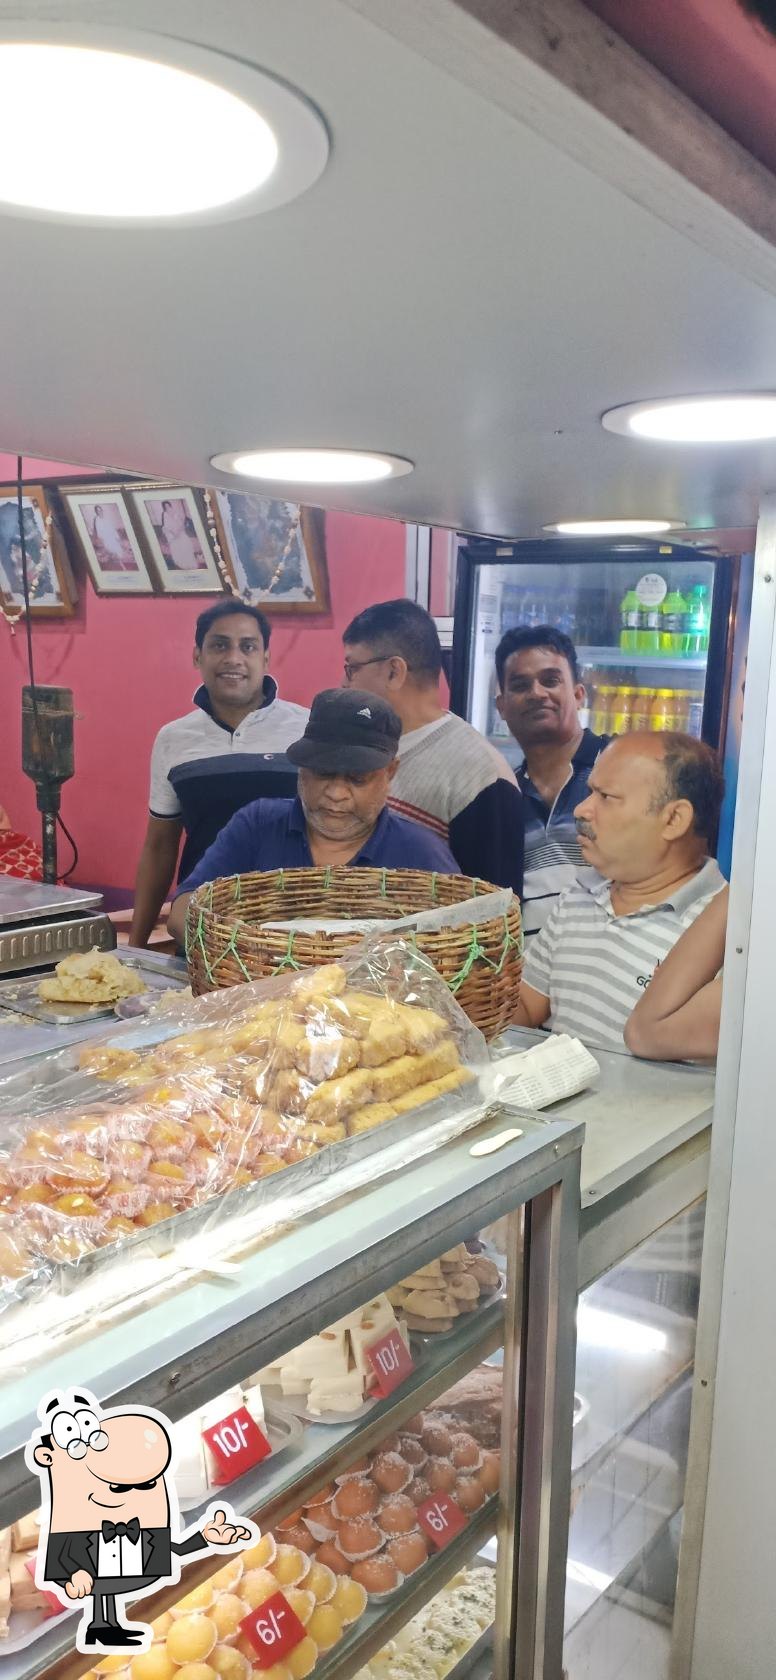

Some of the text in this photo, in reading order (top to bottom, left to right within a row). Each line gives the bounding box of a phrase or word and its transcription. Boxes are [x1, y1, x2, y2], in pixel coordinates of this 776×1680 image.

[375, 1339, 400, 1376] 10/-
[212, 1417, 249, 1458] 10/-
[426, 1502, 448, 1532] 6/-
[255, 1608, 286, 1645] 6/-
